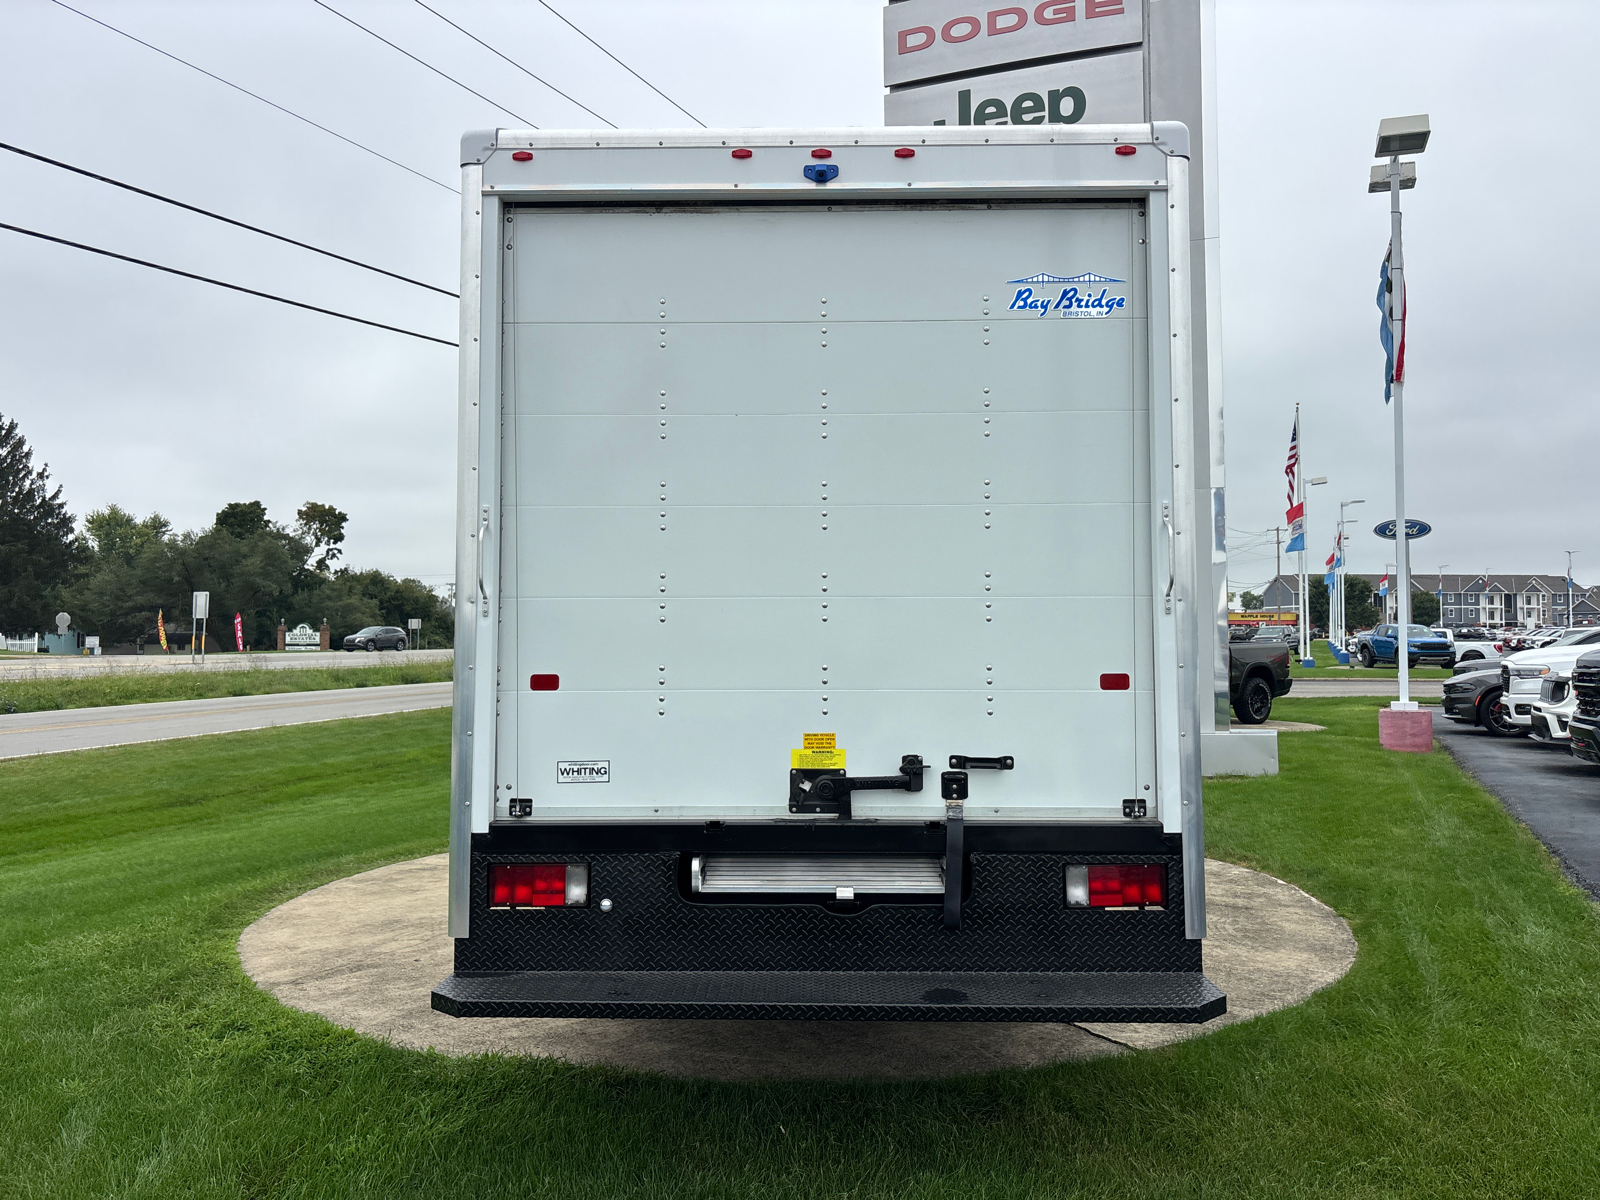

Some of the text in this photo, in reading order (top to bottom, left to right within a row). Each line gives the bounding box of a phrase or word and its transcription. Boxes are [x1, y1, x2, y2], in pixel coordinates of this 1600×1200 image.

[897, 0, 1125, 56] DODGE
[1008, 287, 1126, 317] Bay Bridge
[1386, 522, 1420, 535] Frd
[559, 766, 608, 776] WHITING
